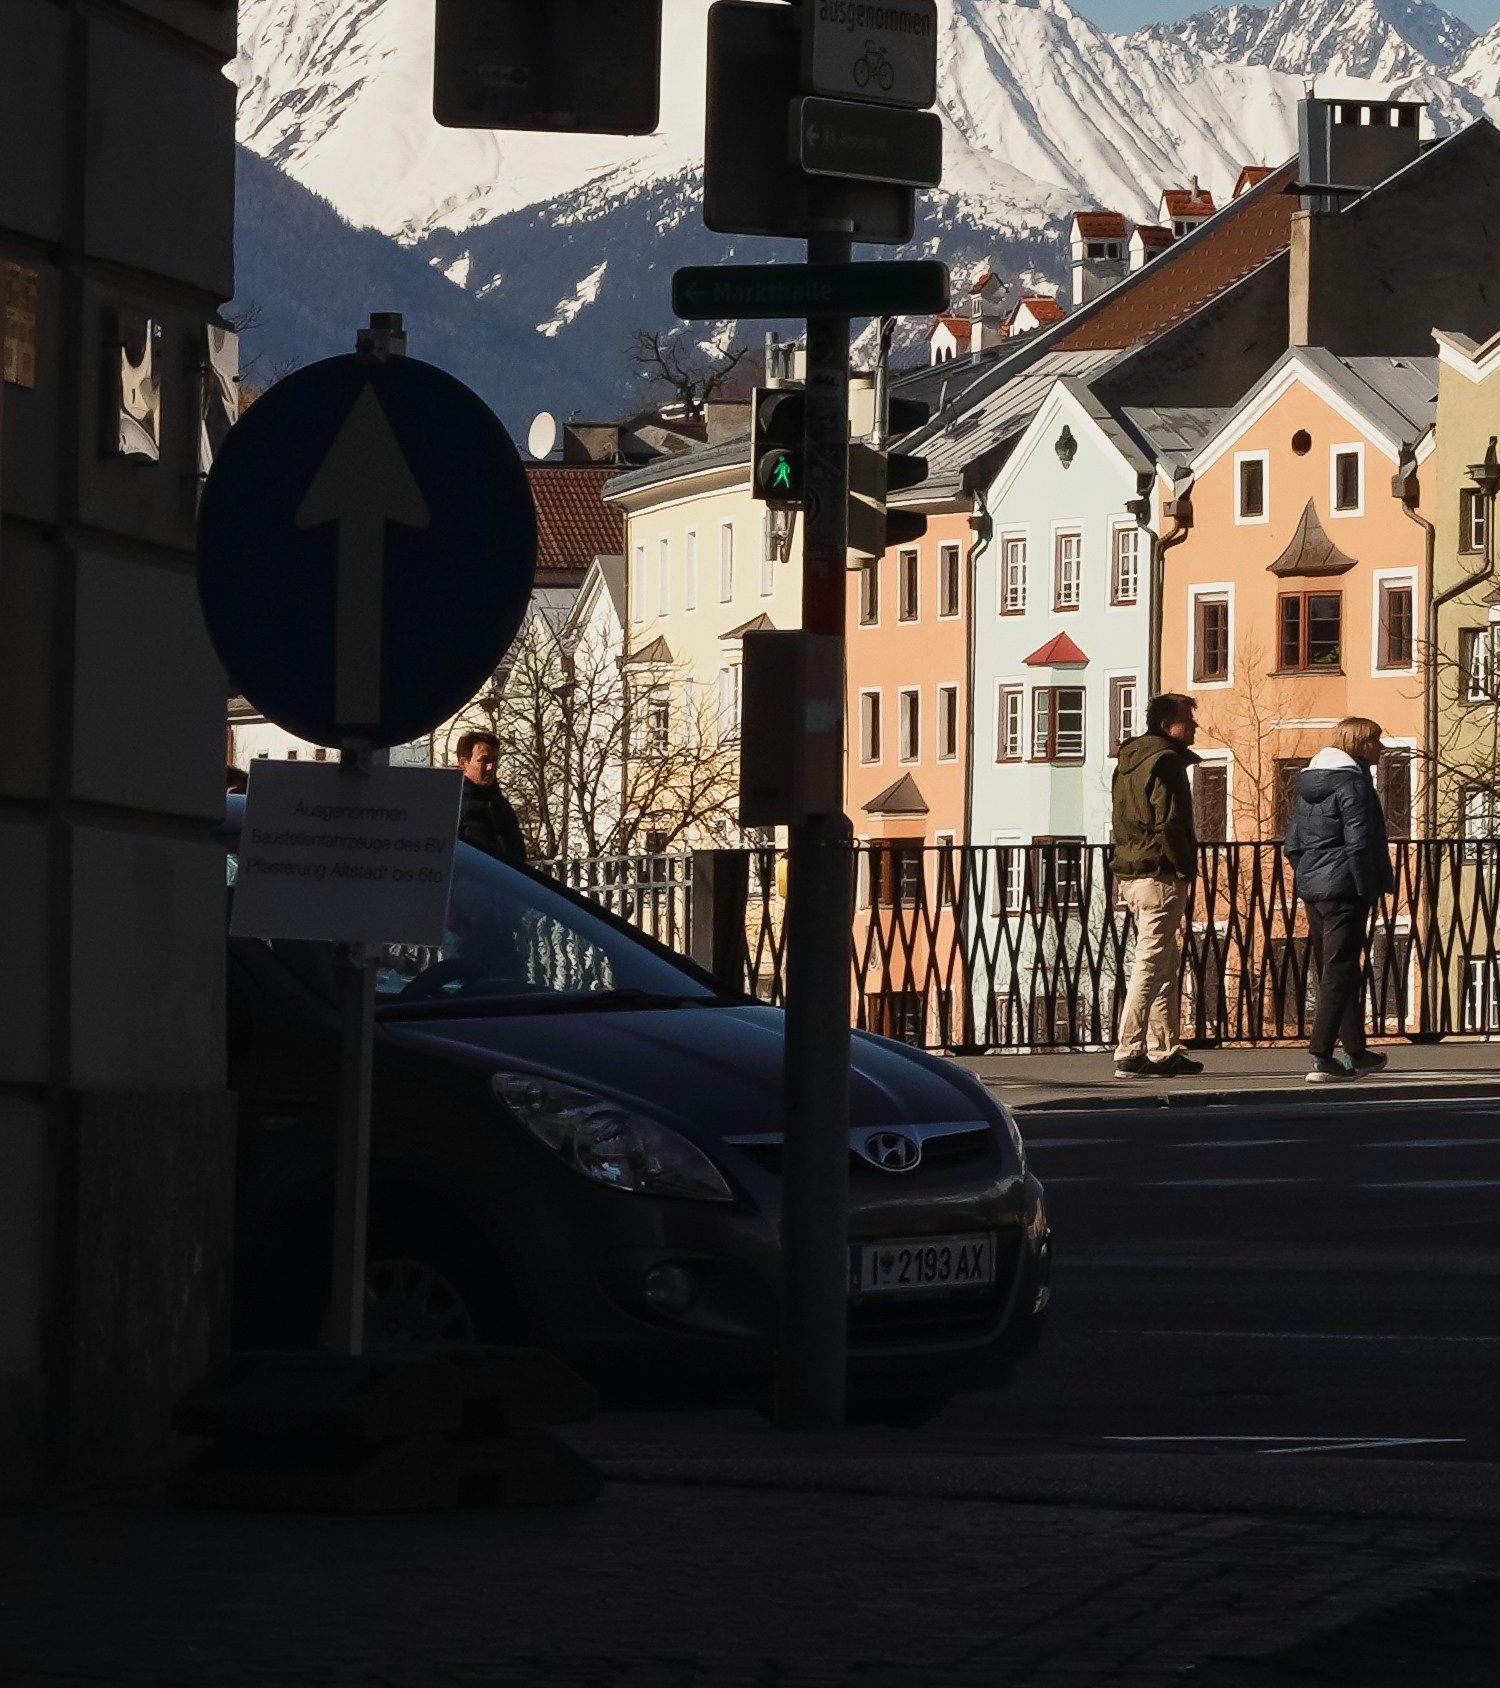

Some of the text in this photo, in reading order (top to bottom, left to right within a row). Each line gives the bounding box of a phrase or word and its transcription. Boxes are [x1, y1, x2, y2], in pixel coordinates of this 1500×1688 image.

[712, 280, 832, 303] Markthalle
[292, 801, 408, 823] Ausgenommen
[250, 828, 447, 854] Baustellenfahrzeuge des BV
[246, 857, 327, 881] Pflasterung
[331, 862, 388, 881] Altstadt
[392, 867, 414, 883] bis
[898, 1246, 951, 1284] 2193
[955, 1243, 984, 1280] AX
